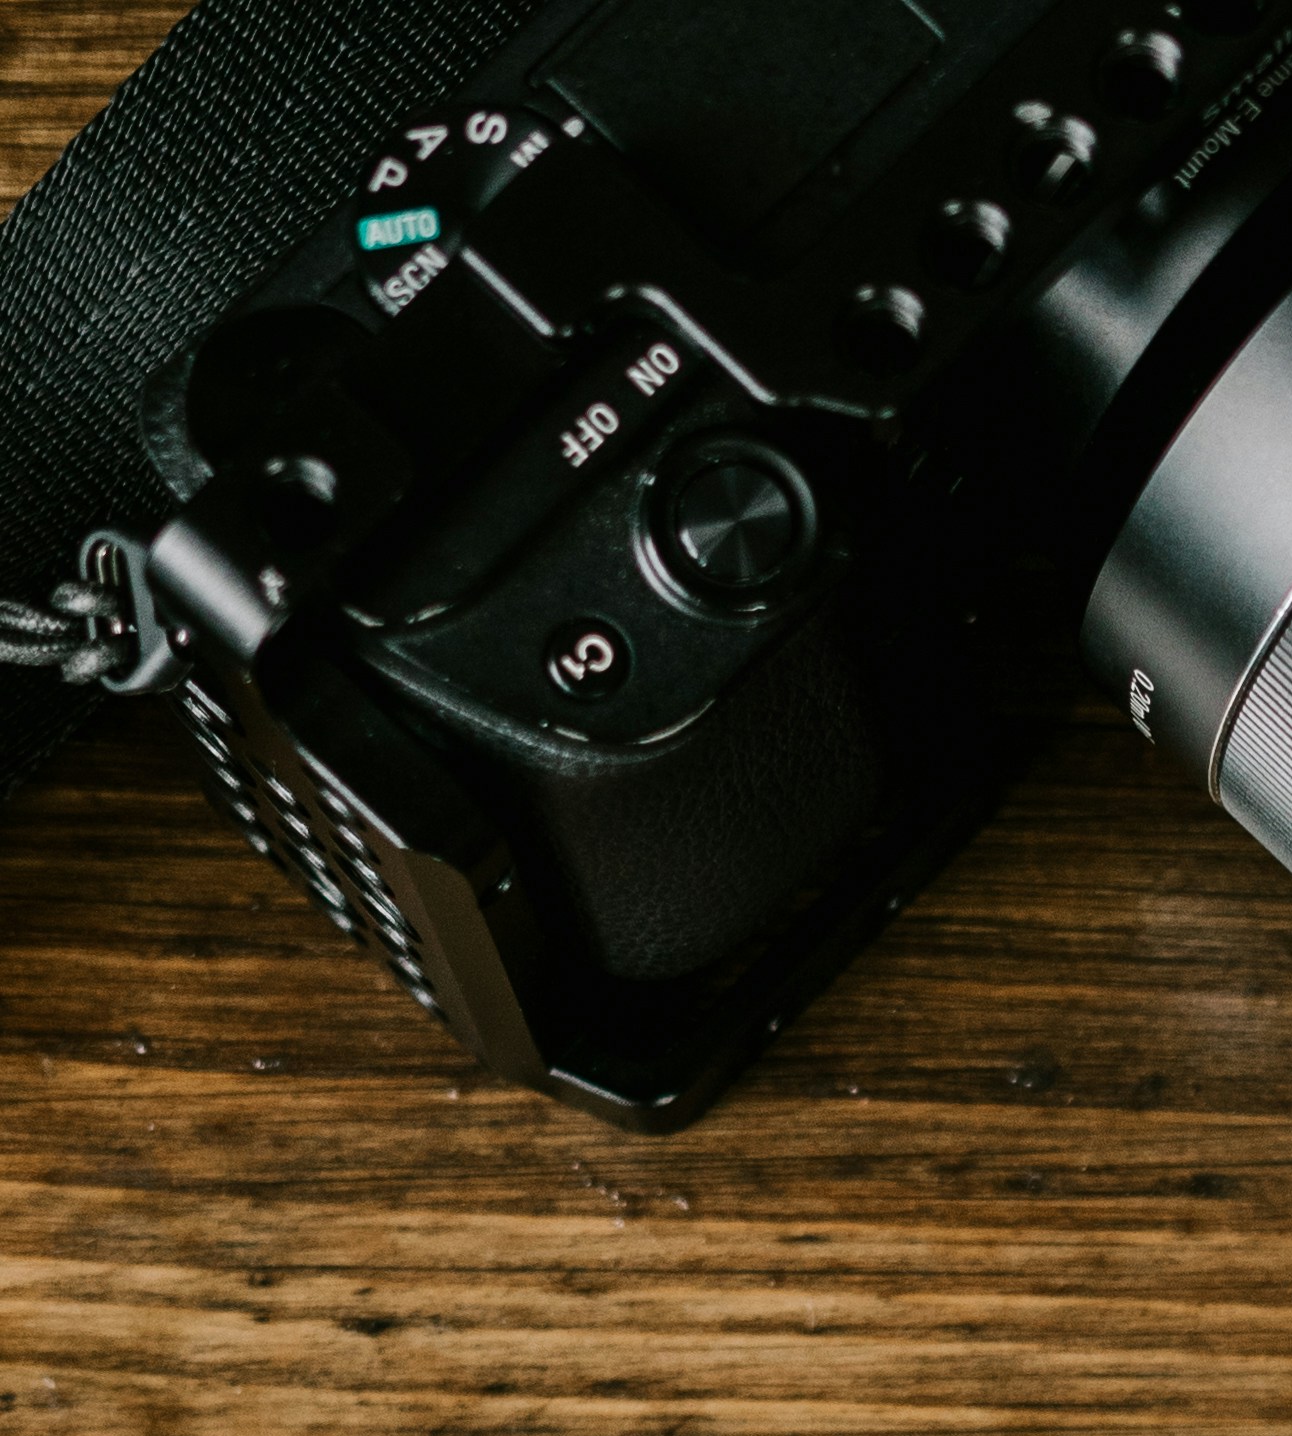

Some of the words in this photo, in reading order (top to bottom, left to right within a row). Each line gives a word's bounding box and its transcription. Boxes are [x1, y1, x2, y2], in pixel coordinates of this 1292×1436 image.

[405, 125, 449, 161] A
[465, 111, 508, 145] S
[1171, 97, 1263, 191] E-Mount
[368, 157, 408, 193] P
[364, 208, 437, 247] AUTO
[383, 243, 449, 307] SCN
[626, 343, 680, 397] ON
[561, 402, 620, 468] OFF
[561, 634, 613, 681] C1
